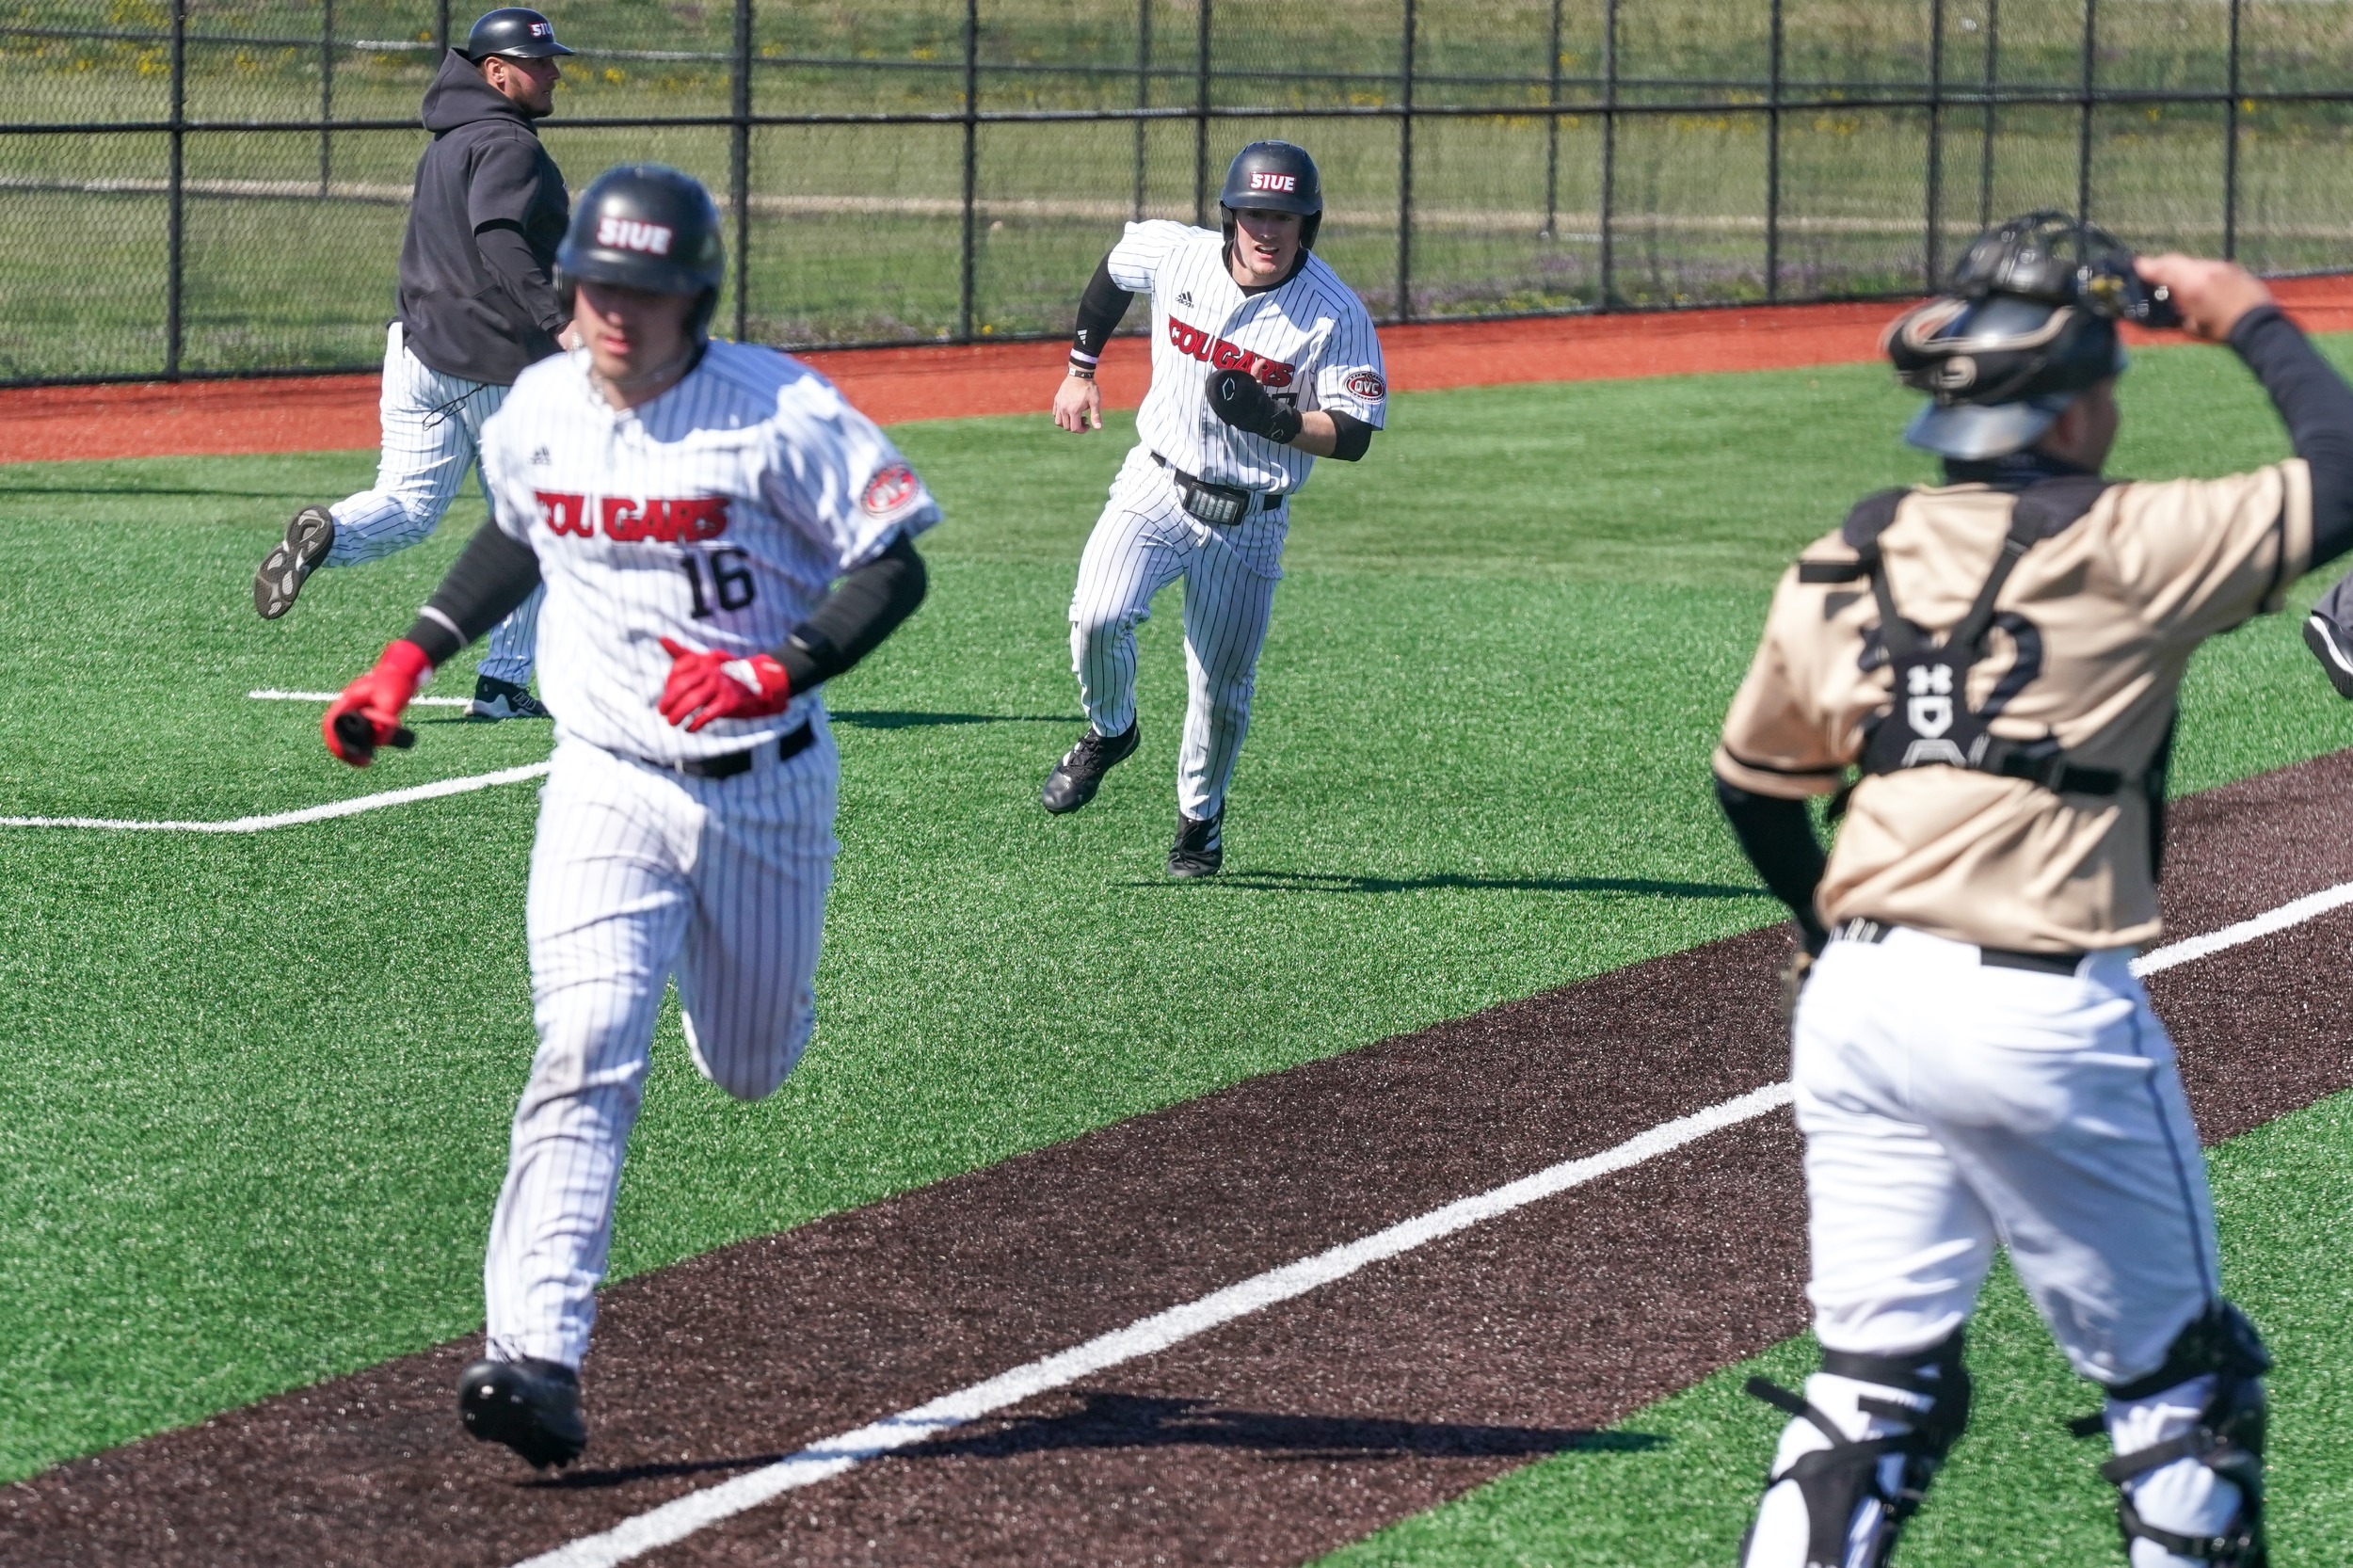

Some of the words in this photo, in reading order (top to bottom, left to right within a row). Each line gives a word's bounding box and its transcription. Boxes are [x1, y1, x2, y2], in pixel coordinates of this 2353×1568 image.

[530, 23, 553, 37] SIU
[1250, 172, 1296, 192] SIUE
[598, 217, 672, 255] SIUE
[1353, 379, 1380, 395] OVC
[681, 548, 756, 619] 16
